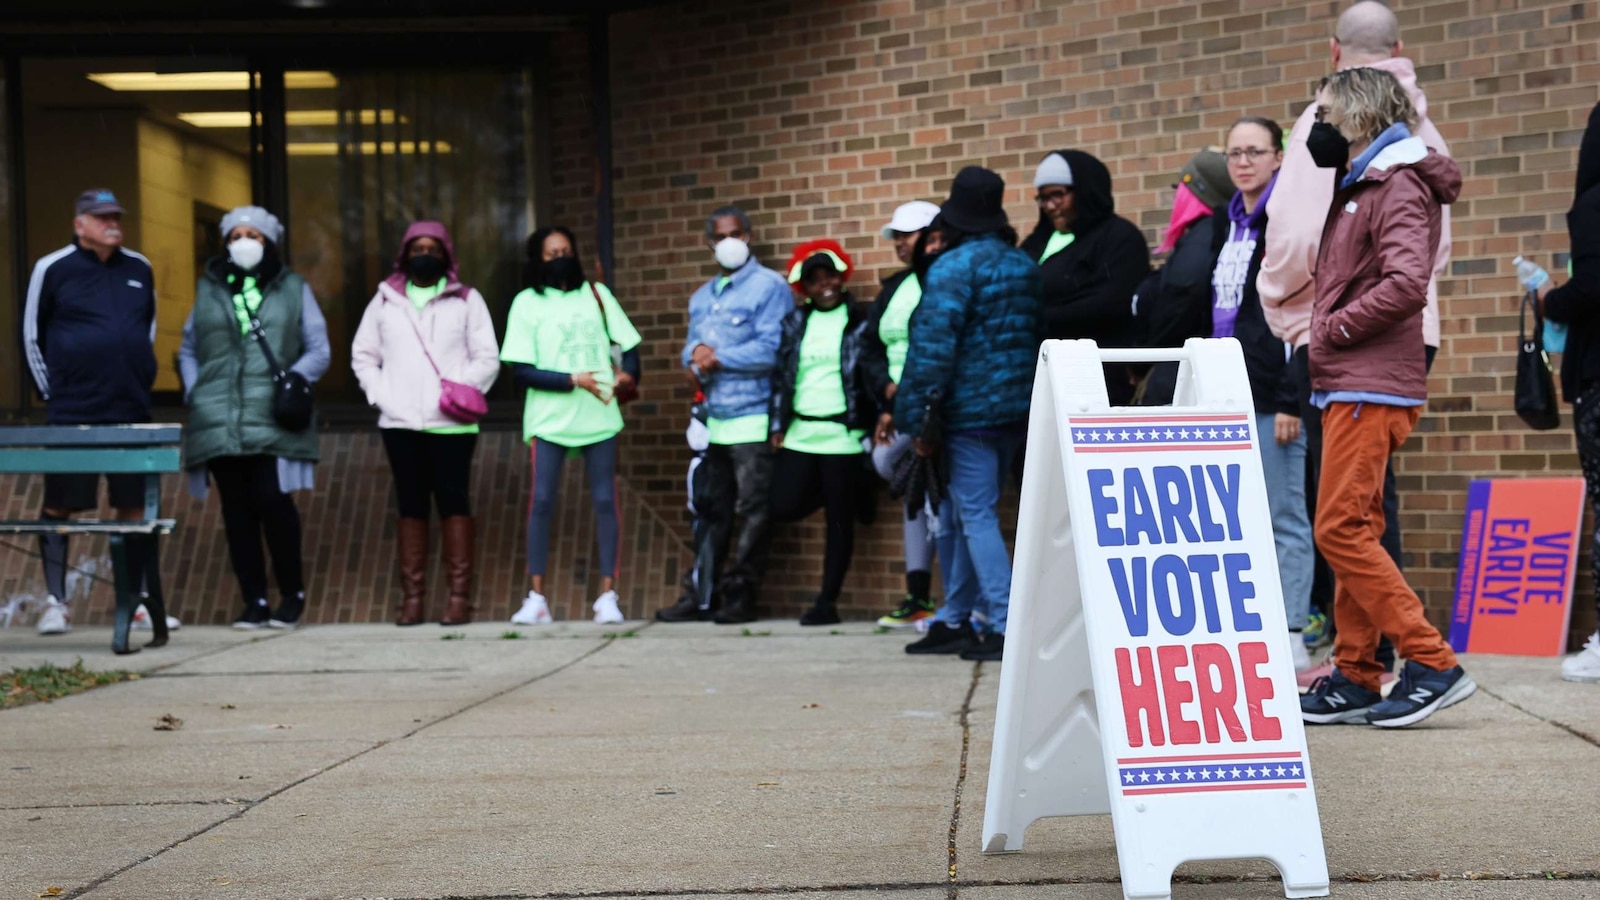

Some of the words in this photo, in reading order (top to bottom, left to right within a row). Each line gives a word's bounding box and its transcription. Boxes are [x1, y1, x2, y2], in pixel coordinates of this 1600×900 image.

[1087, 463, 1243, 547] EARLY
[1107, 553, 1262, 637] VOTE
[1478, 518, 1531, 615] EARLY!
[1524, 531, 1572, 605] VOTE
[1114, 641, 1282, 748] HERE
[1324, 692, 1347, 708] N
[1408, 687, 1433, 704] N
